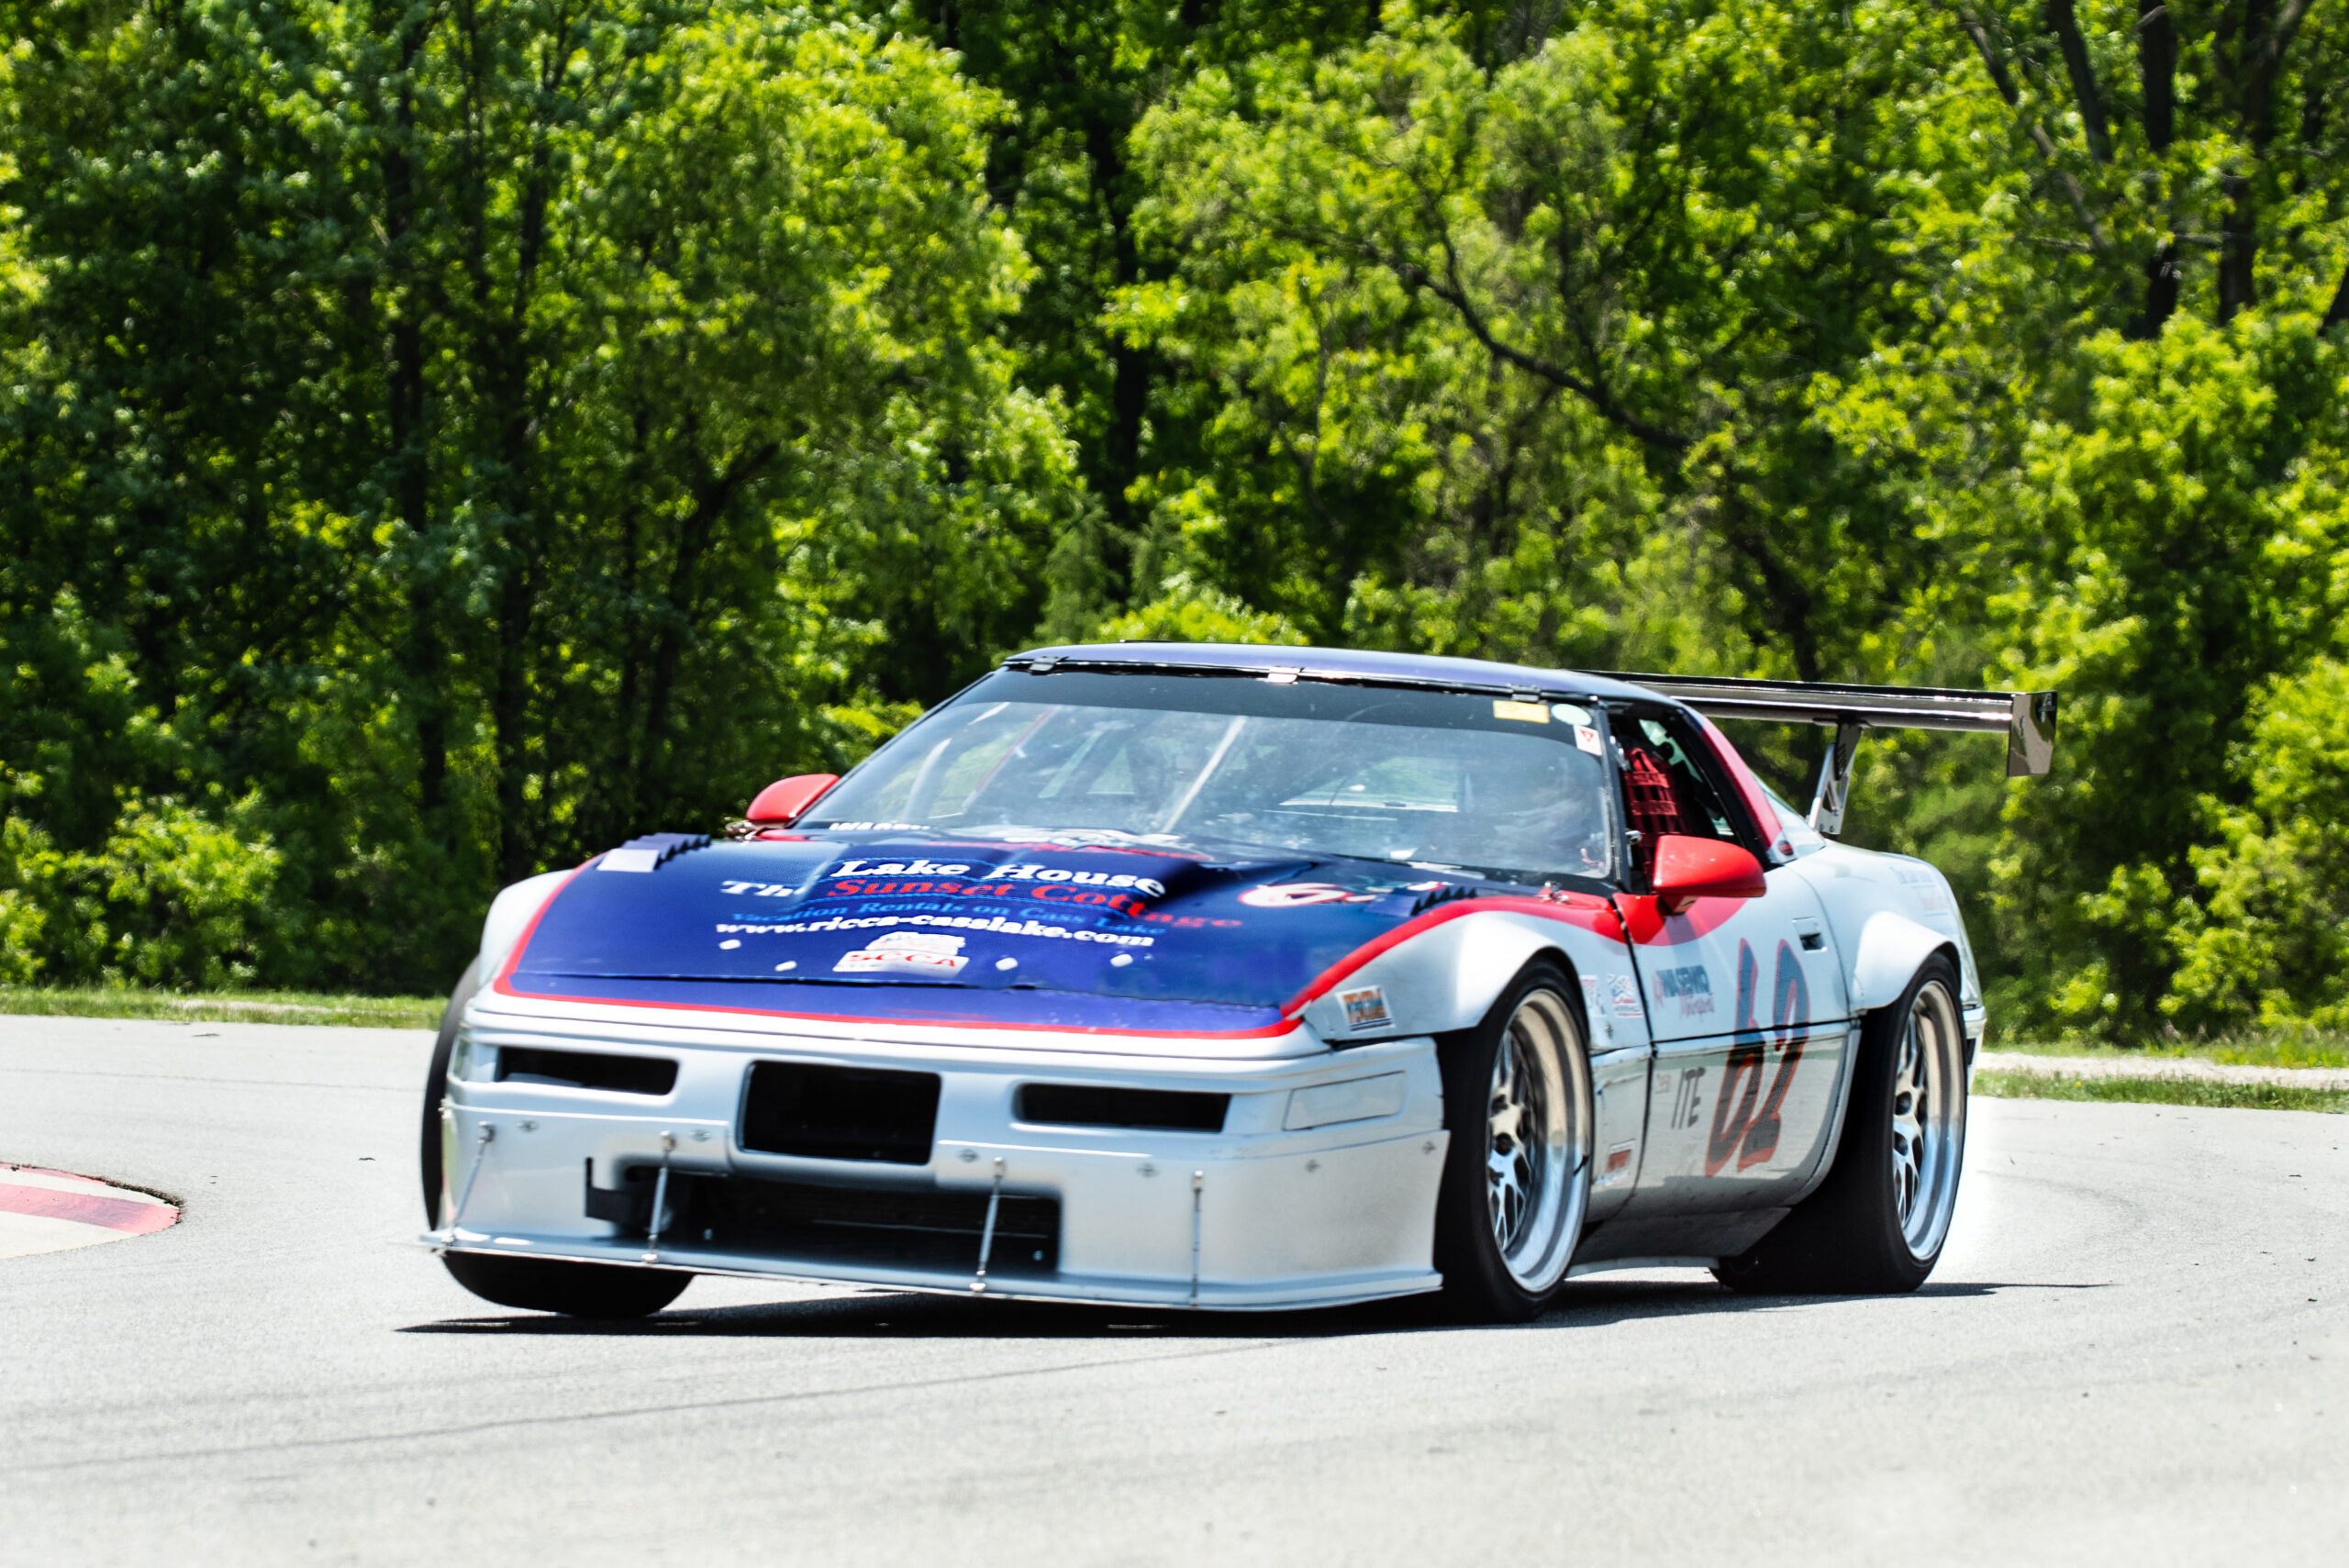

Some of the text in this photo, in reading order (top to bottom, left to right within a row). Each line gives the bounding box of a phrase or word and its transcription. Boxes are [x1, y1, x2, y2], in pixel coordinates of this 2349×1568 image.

[827, 879, 1014, 897] Sunset
[829, 860, 971, 877] Lake
[982, 864, 1166, 897] House
[857, 902, 965, 914] Rentals
[972, 905, 1009, 915] on
[1019, 906, 1085, 924] Cass
[1096, 917, 1167, 934] Lake
[1705, 937, 1810, 1177] 62
